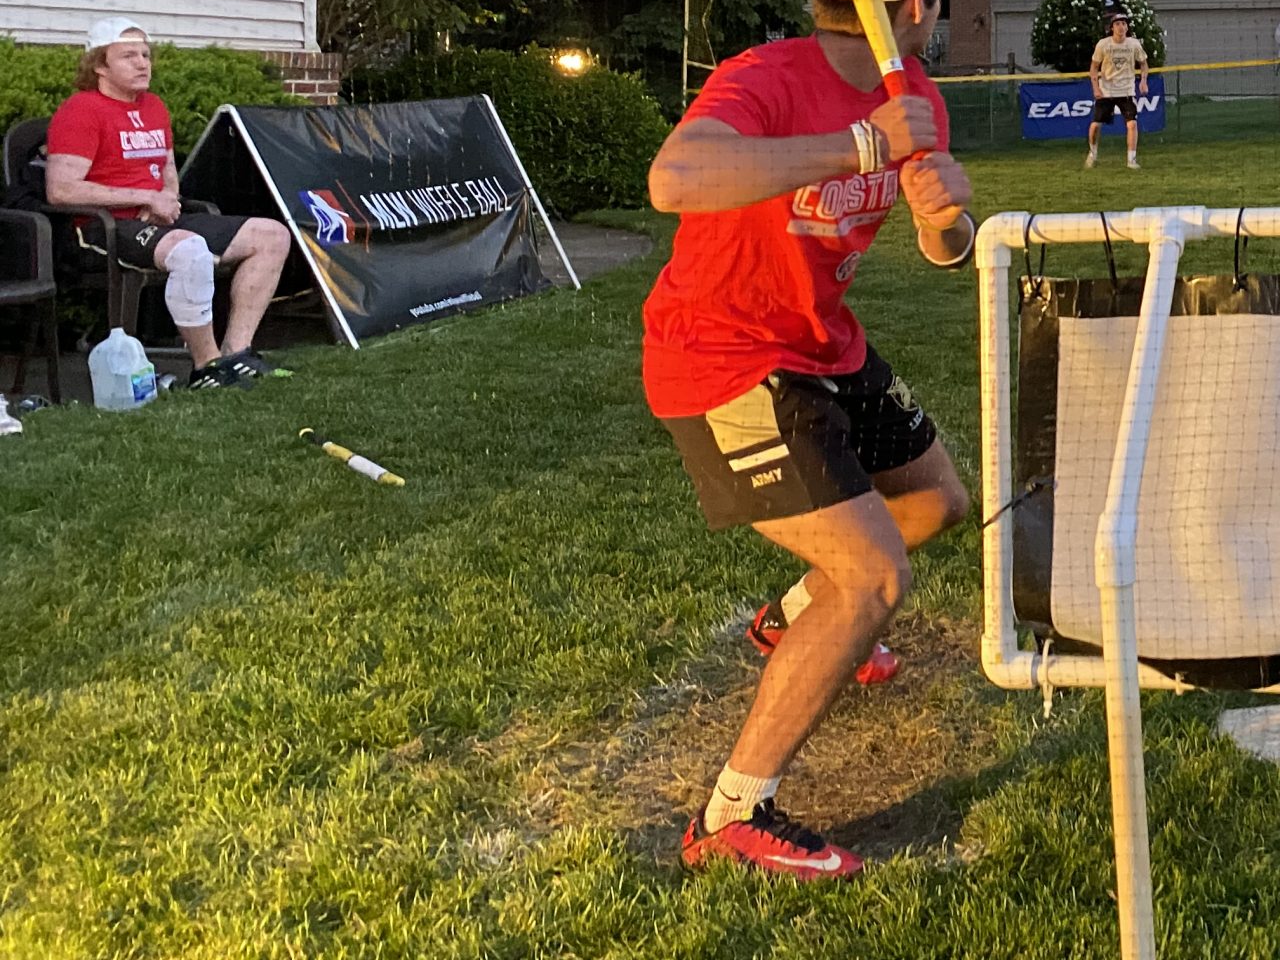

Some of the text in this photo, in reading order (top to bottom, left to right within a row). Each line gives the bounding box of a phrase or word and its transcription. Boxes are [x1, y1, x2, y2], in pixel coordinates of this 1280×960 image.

[1027, 95, 1160, 118] EASN
[359, 176, 512, 231] MLW WIFFLE BALL
[750, 467, 783, 488] ARMY
